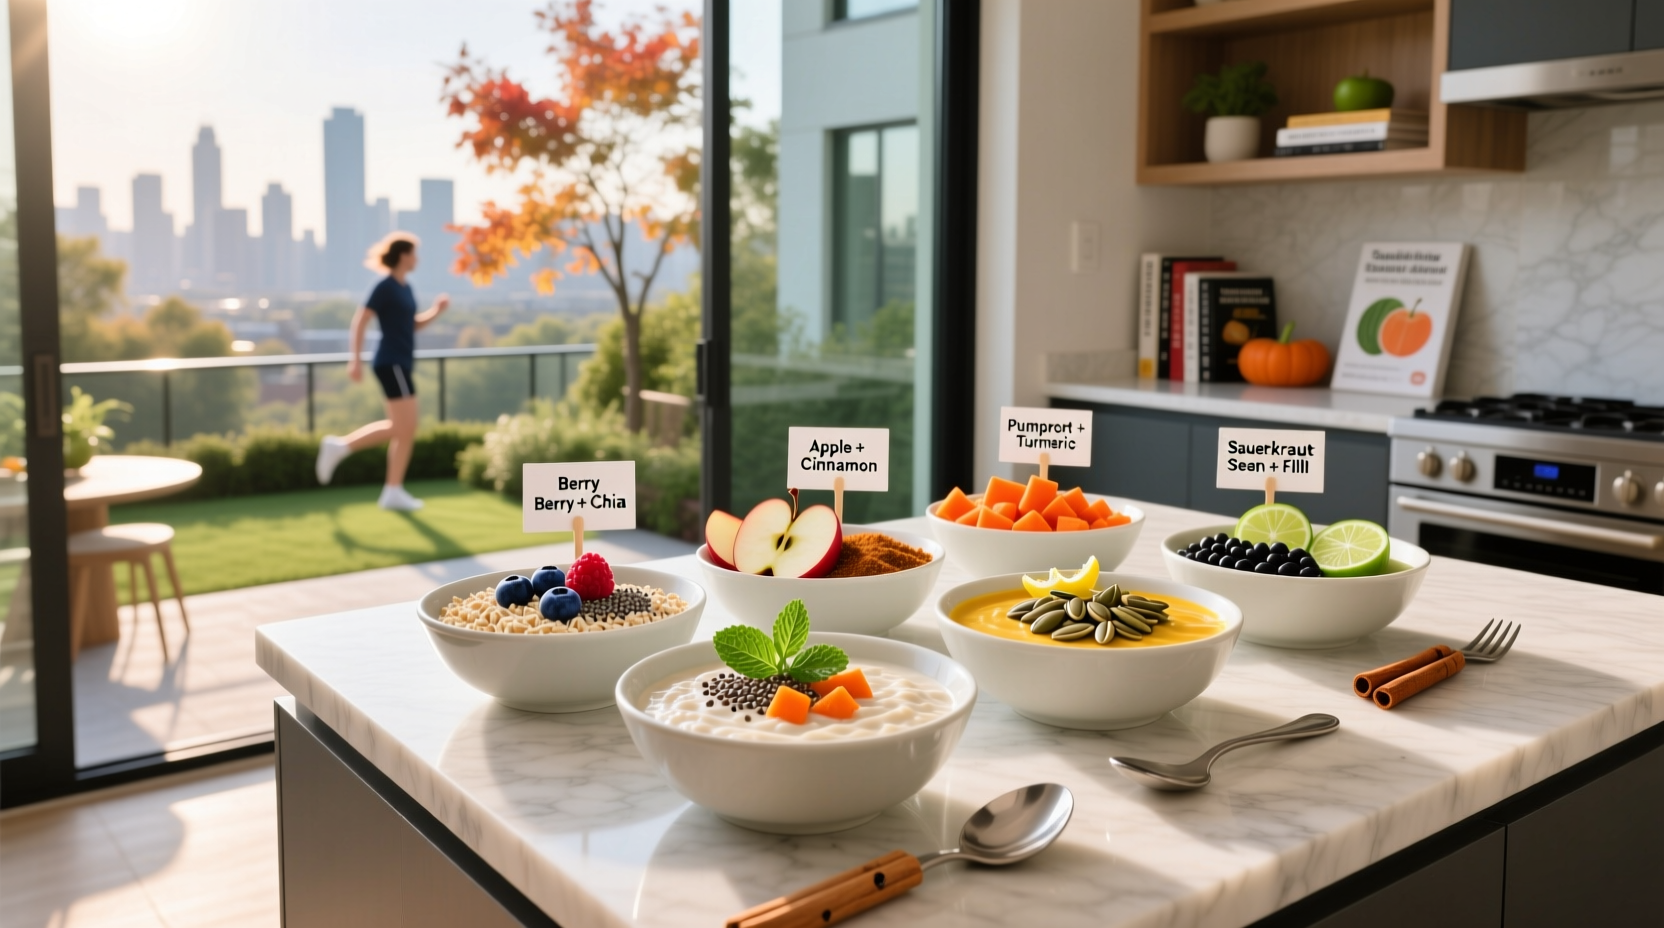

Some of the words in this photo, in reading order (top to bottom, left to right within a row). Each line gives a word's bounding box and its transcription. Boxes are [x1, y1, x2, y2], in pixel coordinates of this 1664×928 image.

[1077, 423, 1085, 433] +
[809, 439, 852, 457] Apple
[856, 443, 865, 452] +
[1016, 435, 1076, 450] Turmeric
[1228, 440, 1315, 456] Sauerkraut
[801, 457, 877, 472] Cinnamon
[1227, 458, 1265, 473] Sean
[1269, 462, 1278, 473] +
[558, 476, 600, 493] Berry
[535, 497, 574, 514] Berry
[577, 498, 586, 508] +
[590, 494, 626, 509] Chia
